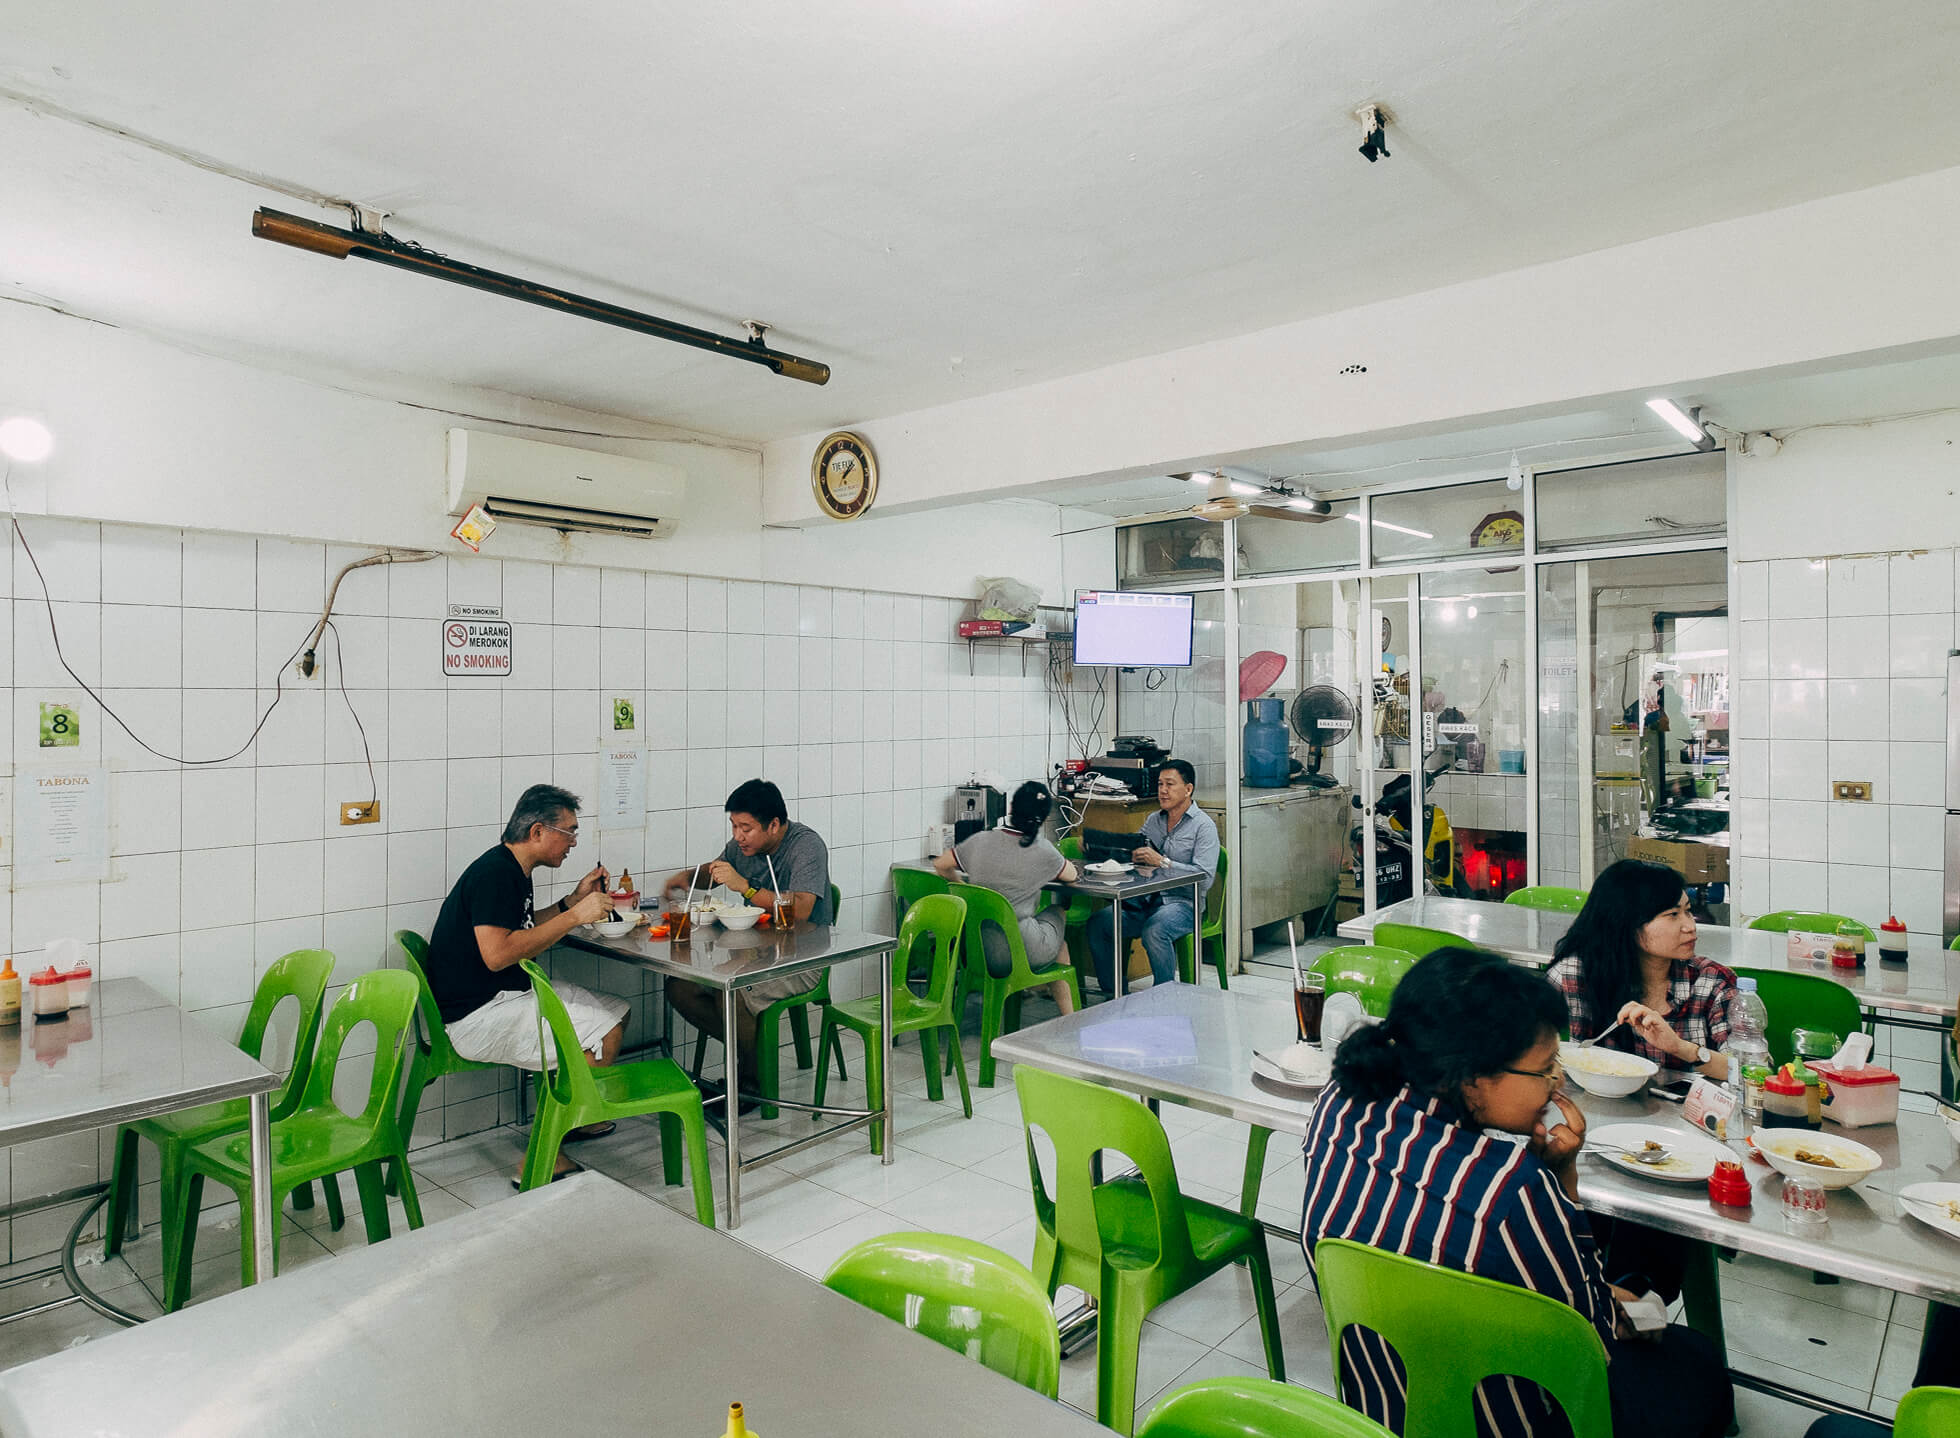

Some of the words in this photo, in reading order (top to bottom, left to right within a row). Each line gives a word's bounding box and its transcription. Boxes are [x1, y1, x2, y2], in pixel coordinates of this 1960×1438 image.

[469, 626, 477, 636] DI
[479, 626, 509, 637] LARANG
[469, 637, 509, 648] MEROKOK
[446, 654, 461, 668] NO
[463, 654, 509, 668] SMOKING
[620, 706, 629, 721] 9
[52, 713, 69, 734] 8
[36, 776, 91, 787] TABONA
